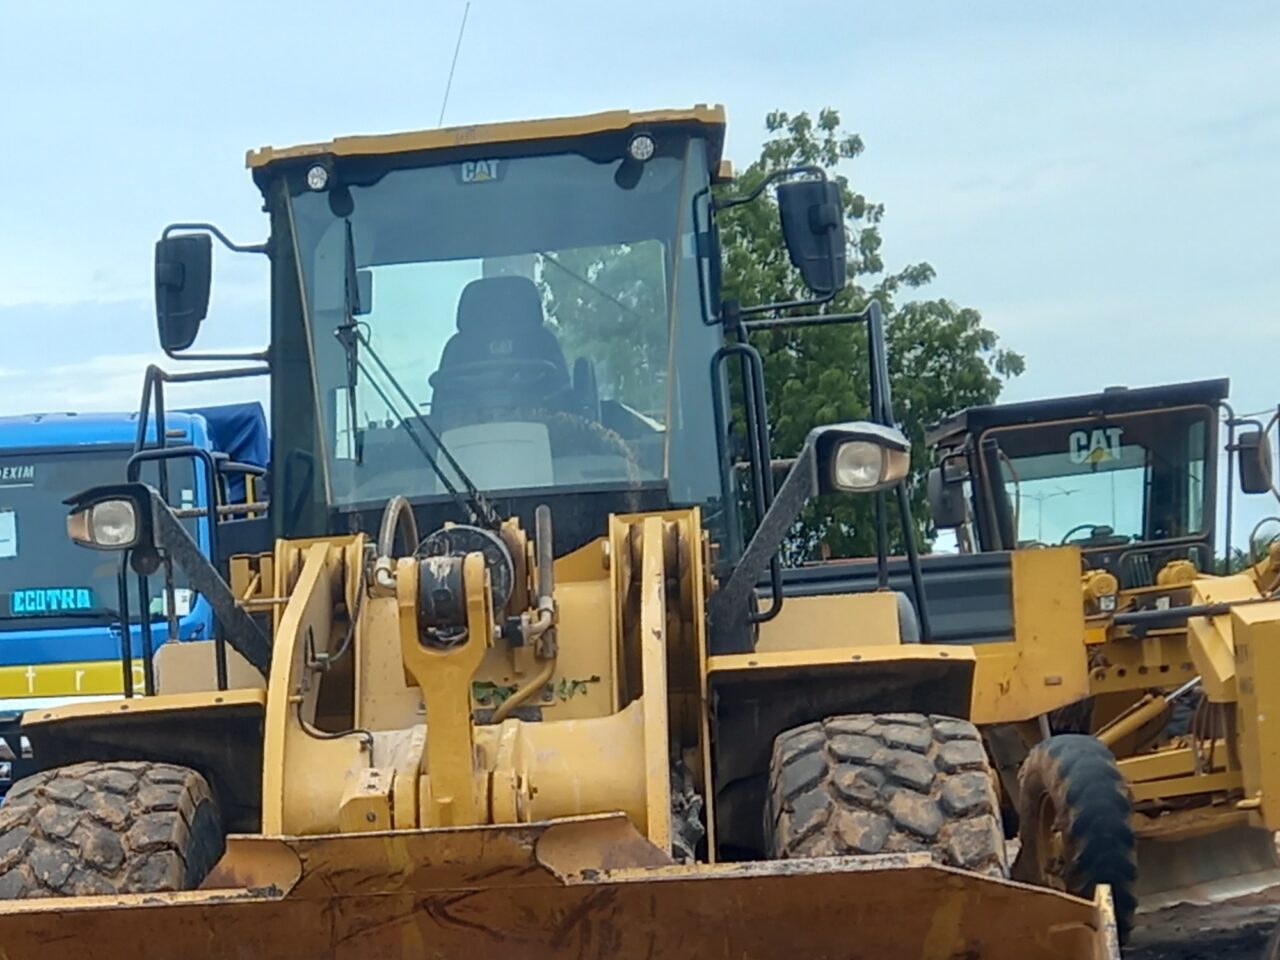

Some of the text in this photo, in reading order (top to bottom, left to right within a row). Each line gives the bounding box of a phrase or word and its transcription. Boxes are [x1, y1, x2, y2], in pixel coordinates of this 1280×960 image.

[462, 159, 500, 182] CAT
[1069, 428, 1124, 464] CAT
[14, 588, 92, 613] ECOTRA
